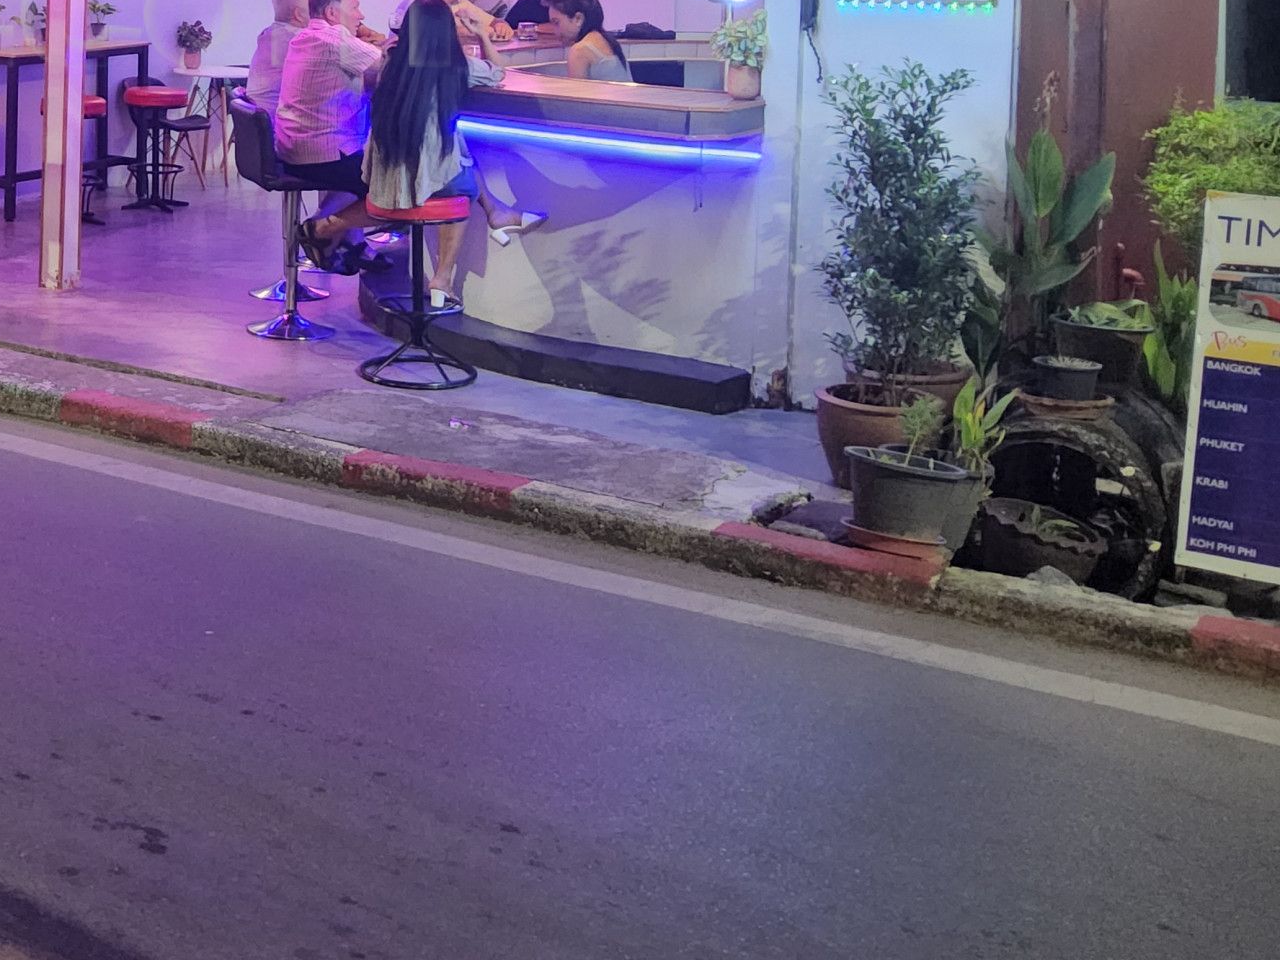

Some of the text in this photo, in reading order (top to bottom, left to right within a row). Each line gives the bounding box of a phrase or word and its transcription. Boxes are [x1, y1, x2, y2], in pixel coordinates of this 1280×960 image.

[1206, 360, 1262, 376] BANGKOK
[1203, 399, 1248, 414] HUAHIN
[1200, 437, 1246, 452] PHUKET
[1195, 476, 1229, 490] KRABI
[1192, 515, 1234, 531] HADYAI
[1189, 537, 1257, 558] KOH PHI PHI
